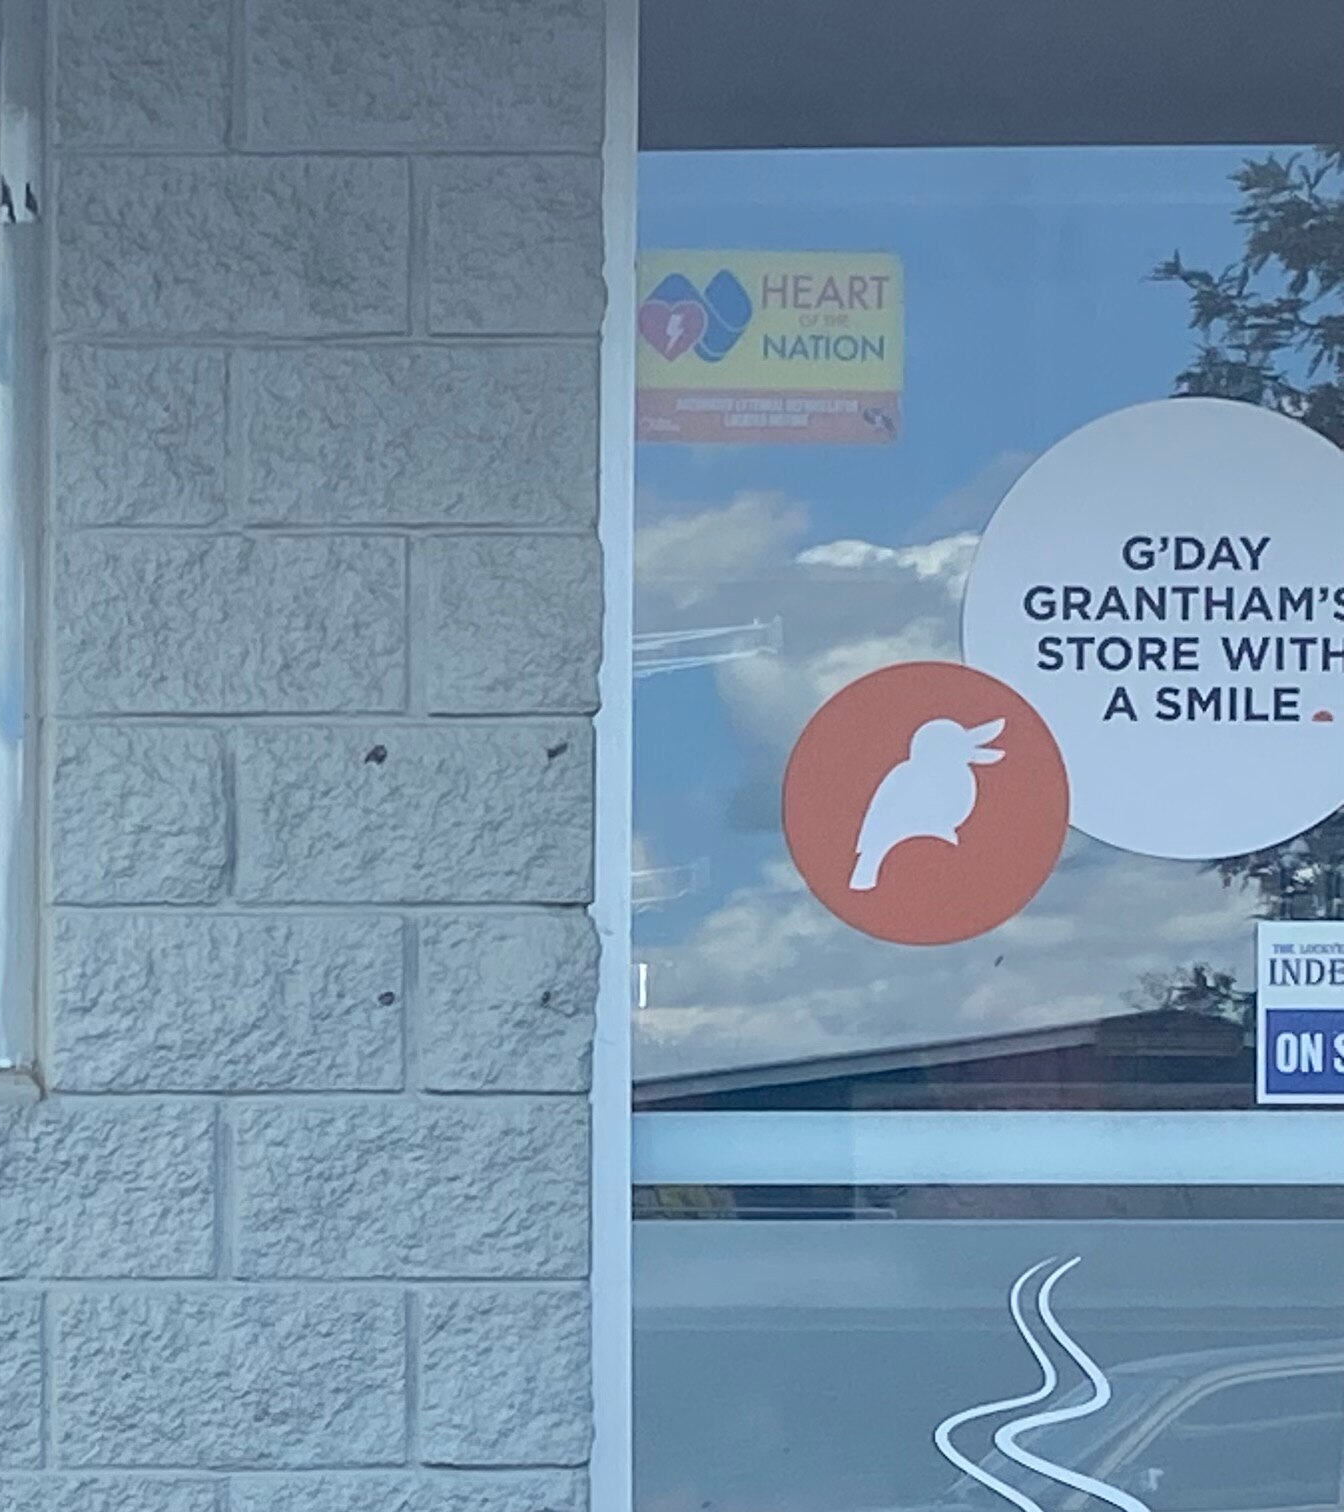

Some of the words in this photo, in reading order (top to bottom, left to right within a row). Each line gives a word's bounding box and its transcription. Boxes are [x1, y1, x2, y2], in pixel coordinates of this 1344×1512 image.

[762, 273, 890, 310] HEART
[763, 333, 885, 362] NATION
[1122, 535, 1271, 571] G'DAY
[1037, 636, 1199, 671] STORE
[1221, 636, 1344, 671] WITH
[1103, 686, 1138, 721] A
[1155, 686, 1301, 721] SMILE
[1276, 1032, 1324, 1074] ON
